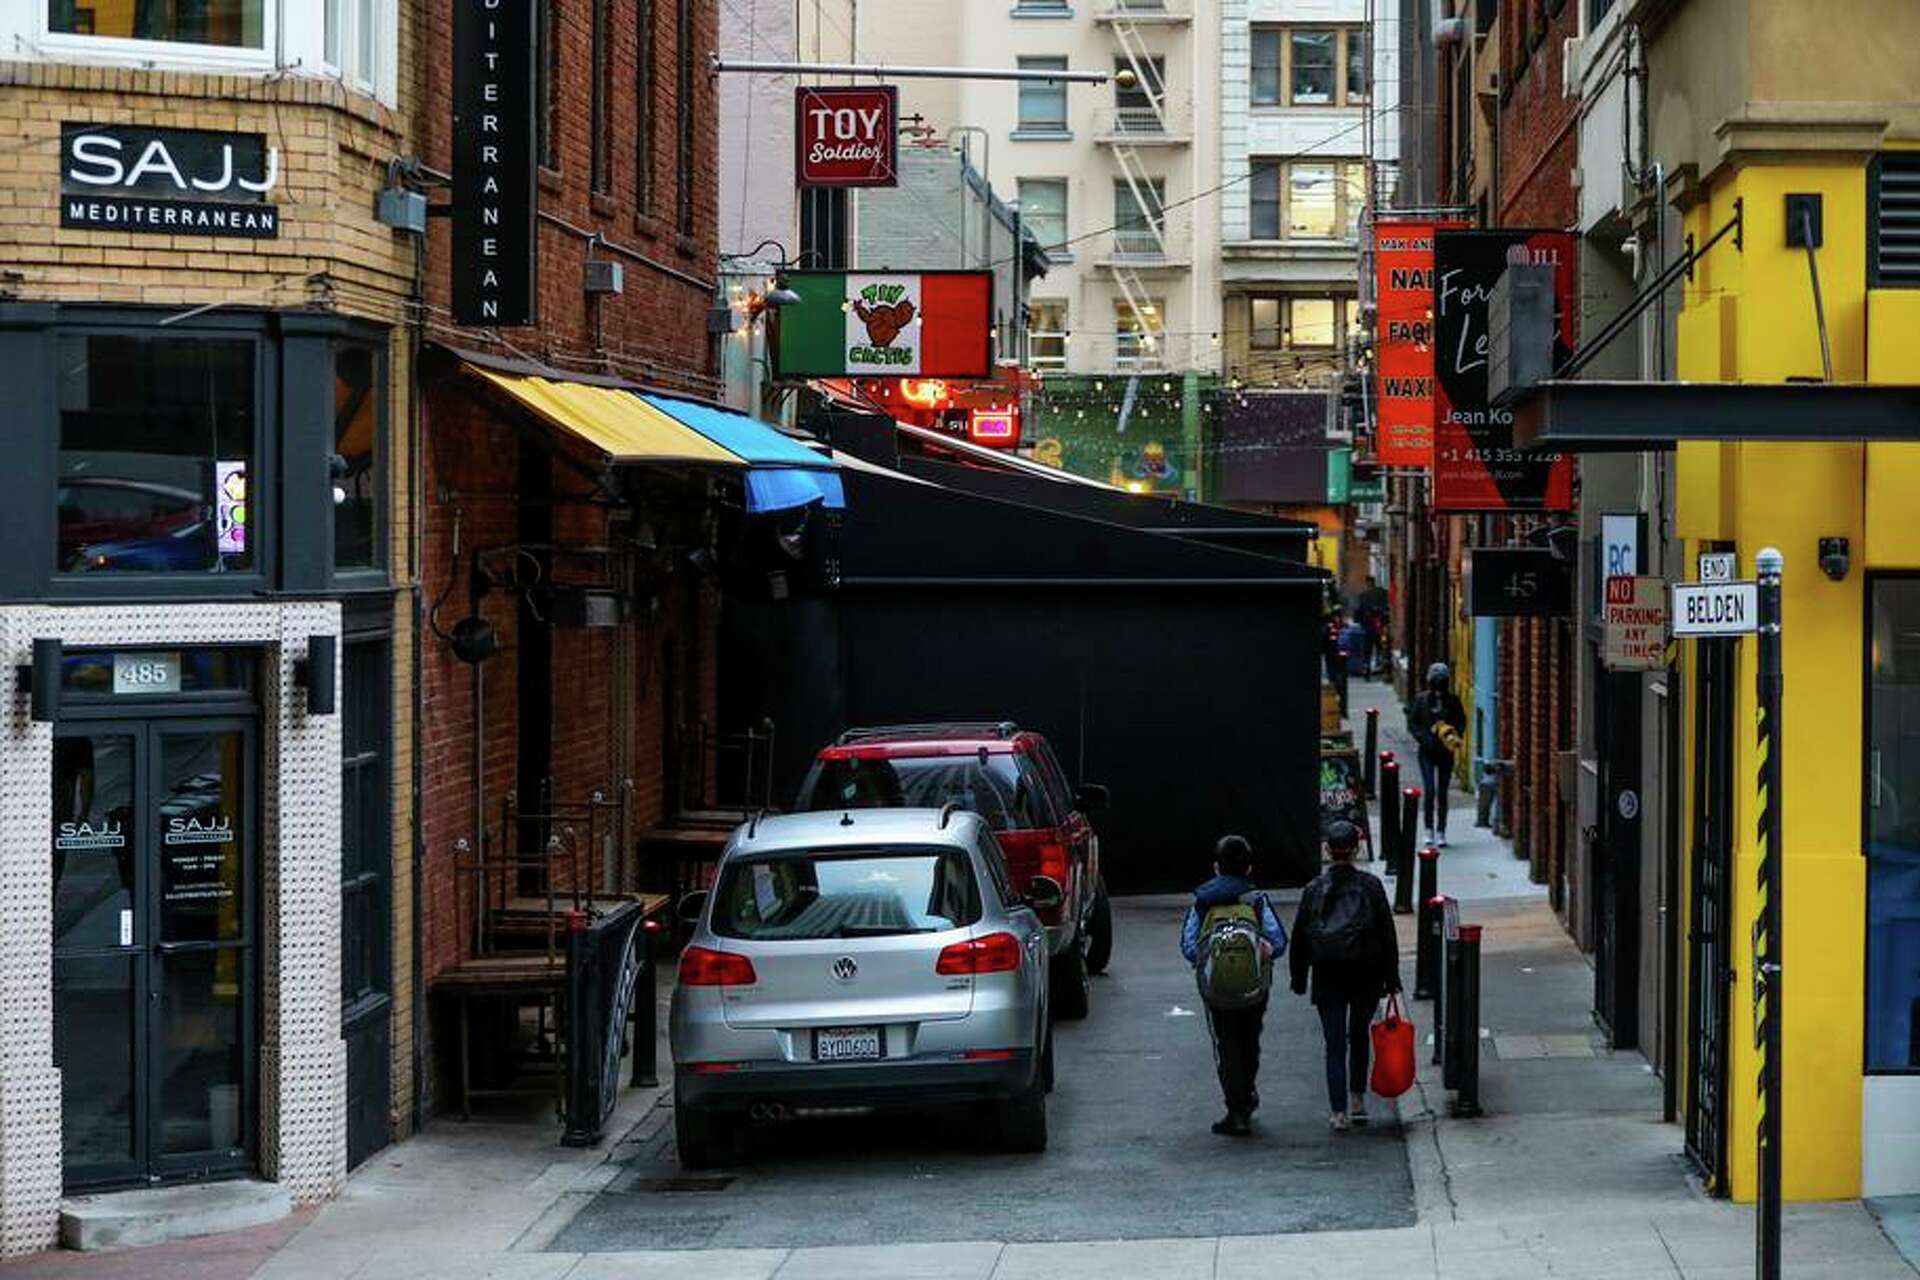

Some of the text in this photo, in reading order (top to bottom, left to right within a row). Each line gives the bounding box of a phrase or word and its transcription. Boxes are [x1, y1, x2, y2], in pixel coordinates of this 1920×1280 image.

[809, 108, 881, 140] TOY
[69, 134, 278, 192] SAJJ
[809, 142, 884, 163] Soldier
[69, 202, 275, 230] MEDITERRANEAN
[1441, 408, 1485, 425] Jean
[1703, 558, 1726, 579] END
[1503, 571, 1536, 598] 45
[1609, 581, 1631, 600] NO
[1609, 607, 1662, 625] PARKING
[1687, 594, 1744, 624] BELDEN
[1624, 628, 1647, 641] ANY
[121, 663, 167, 684] 485
[60, 821, 121, 837] SAJJ
[169, 816, 230, 832] SAJJ
